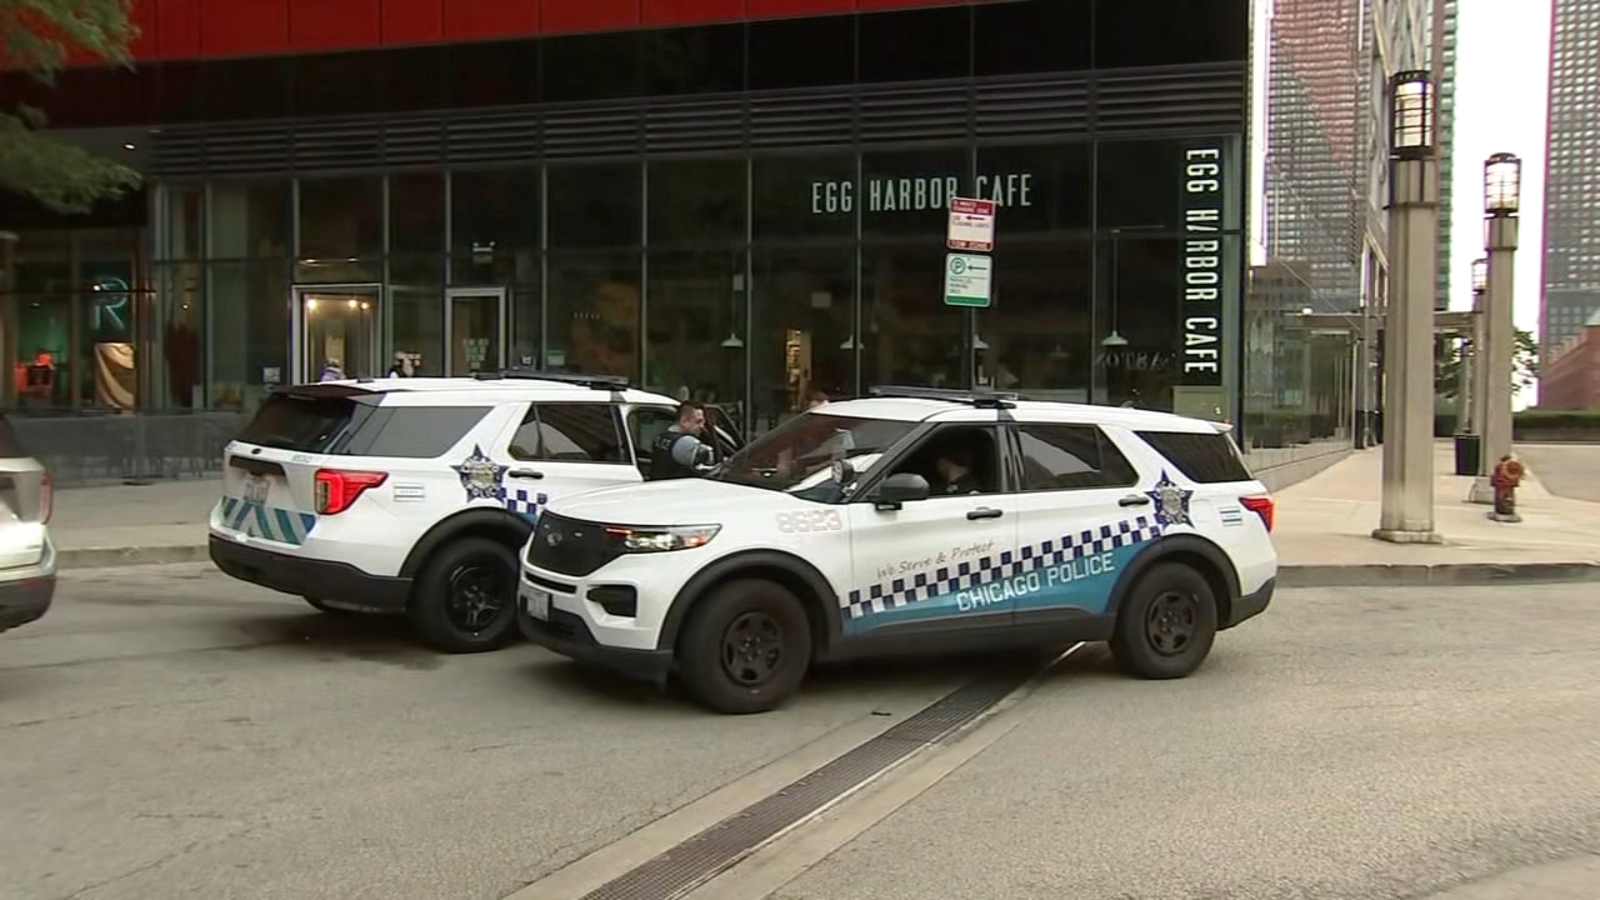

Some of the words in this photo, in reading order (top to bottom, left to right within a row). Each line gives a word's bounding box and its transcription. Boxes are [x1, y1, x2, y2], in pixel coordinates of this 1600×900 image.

[1186, 149, 1219, 192] EGG
[812, 181, 853, 213] EGG
[870, 177, 958, 212] HARBOR
[976, 174, 1032, 206] CAFE
[1186, 209, 1219, 300] HARBOR
[1184, 317, 1218, 373] CAFE
[777, 509, 842, 533] 8623
[935, 552, 946, 564] &
[951, 540, 994, 561] Protect
[956, 572, 1040, 611] CHICAGO
[1047, 552, 1115, 587] POLICE
